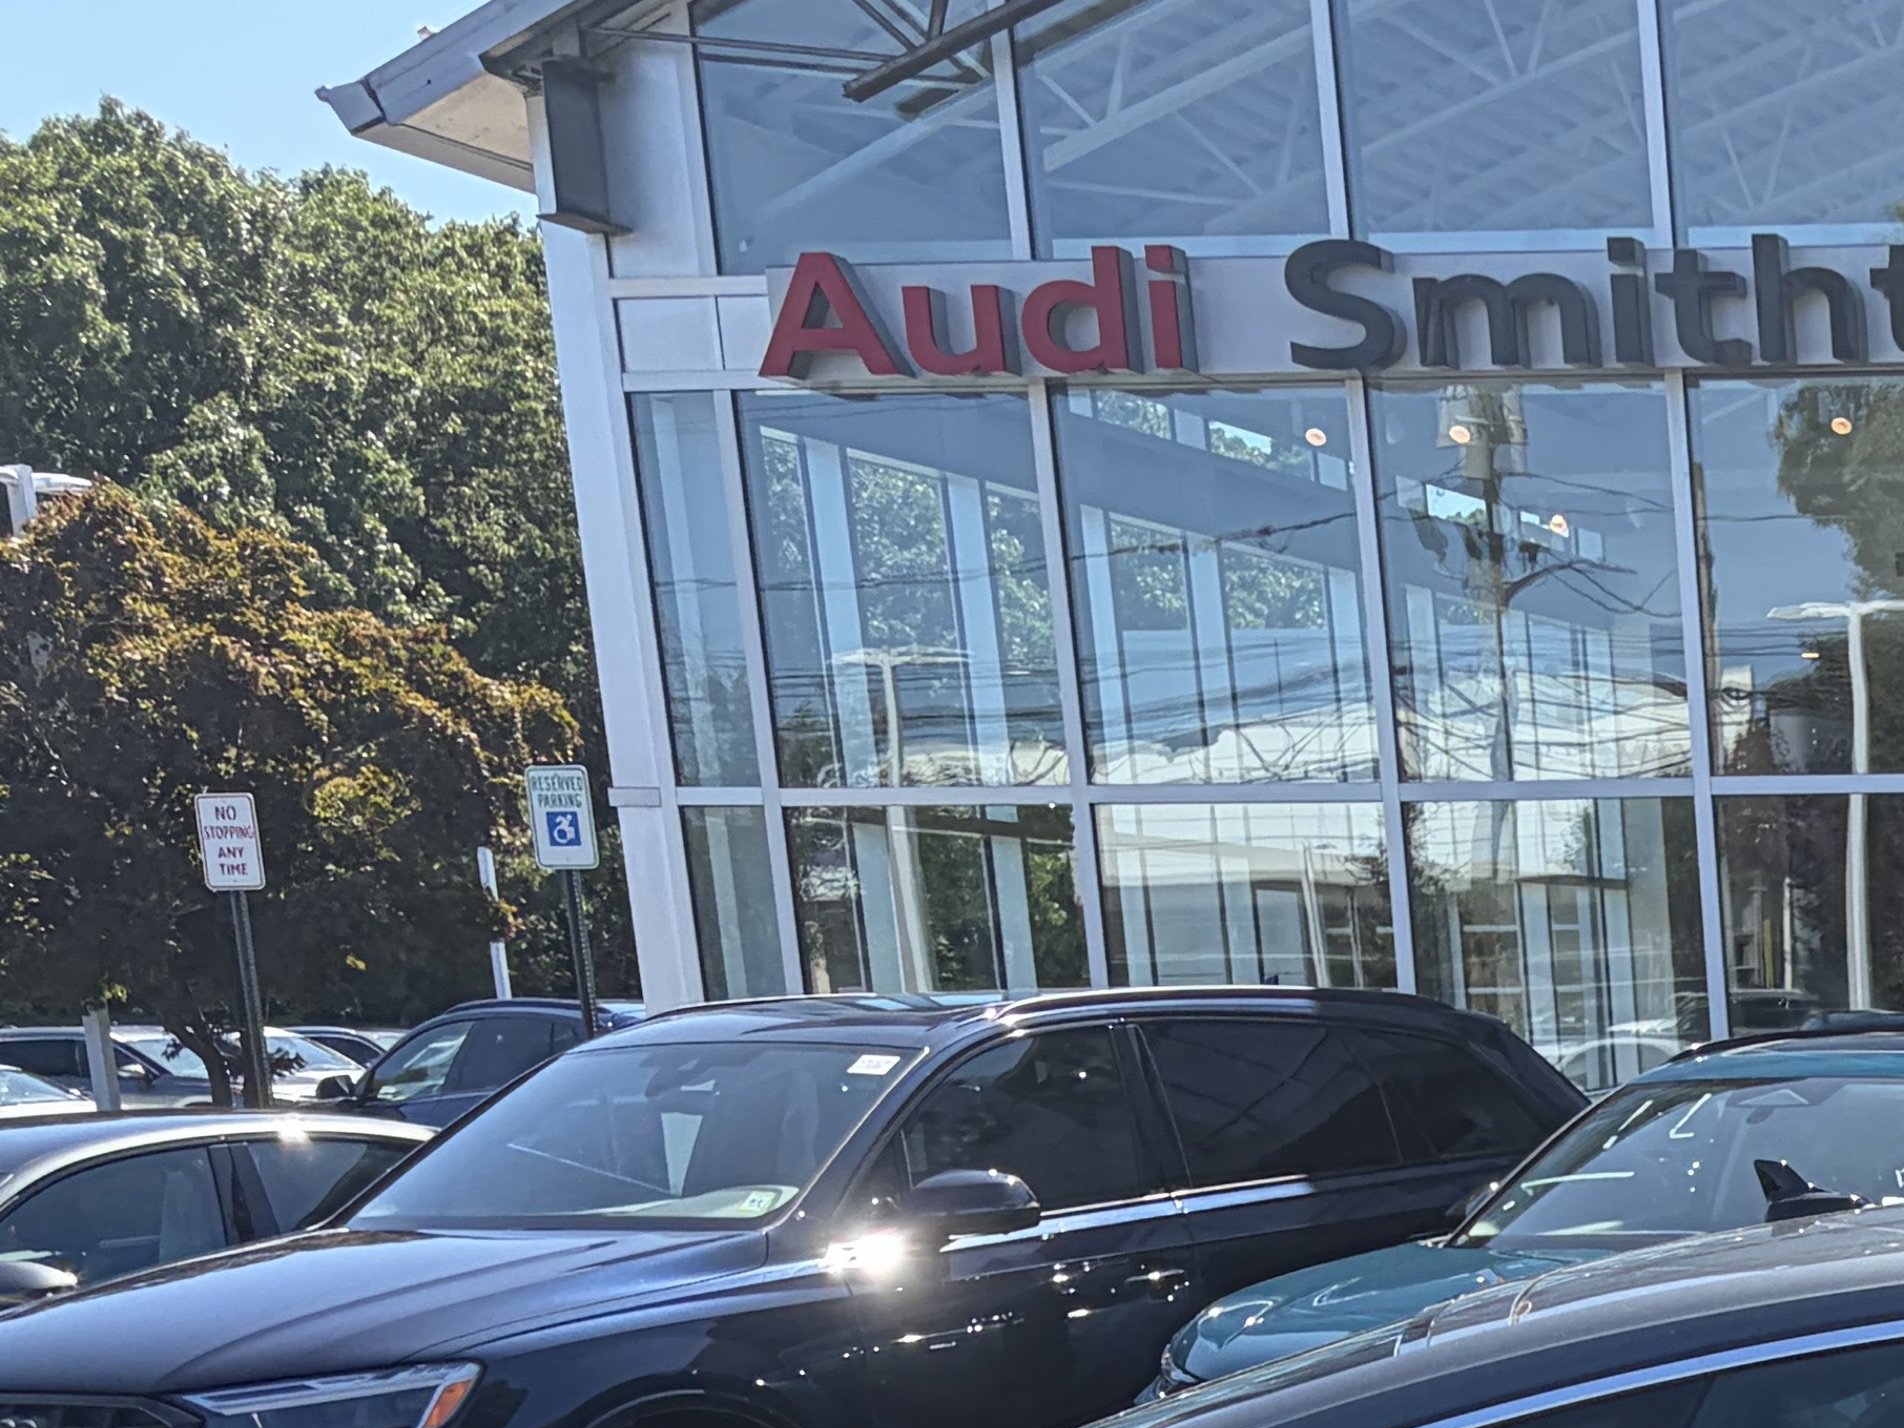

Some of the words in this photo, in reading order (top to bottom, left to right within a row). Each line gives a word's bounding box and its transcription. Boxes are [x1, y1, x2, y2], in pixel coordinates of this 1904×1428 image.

[757, 244, 1198, 377] Audi
[530, 775, 583, 791] RESERVED
[538, 793, 582, 808] PARKING
[215, 805, 237, 820] NO
[204, 825, 256, 840] STOPPING
[218, 846, 244, 859] ANY
[219, 863, 248, 876] TIME
